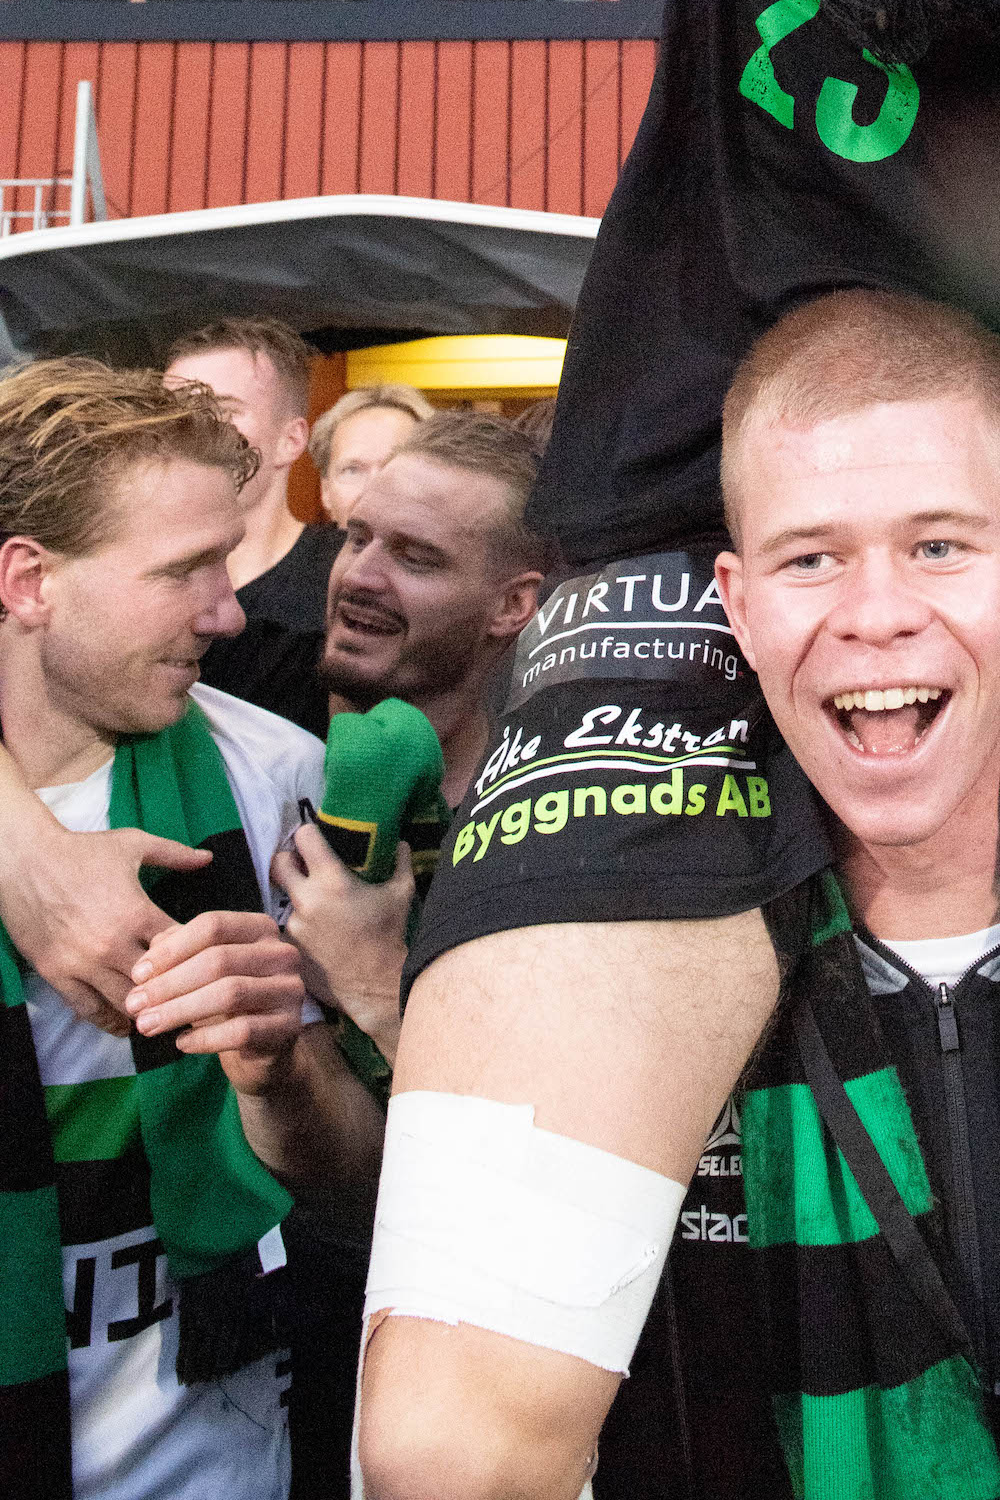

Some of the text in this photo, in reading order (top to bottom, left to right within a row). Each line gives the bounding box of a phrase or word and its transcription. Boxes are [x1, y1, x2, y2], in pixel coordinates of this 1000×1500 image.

[536, 572, 725, 636] VIRTUA
[522, 636, 739, 688] manufacturing
[474, 726, 542, 797] Åke
[453, 768, 772, 868] Byggnads AB
[697, 1155, 743, 1177] SELE
